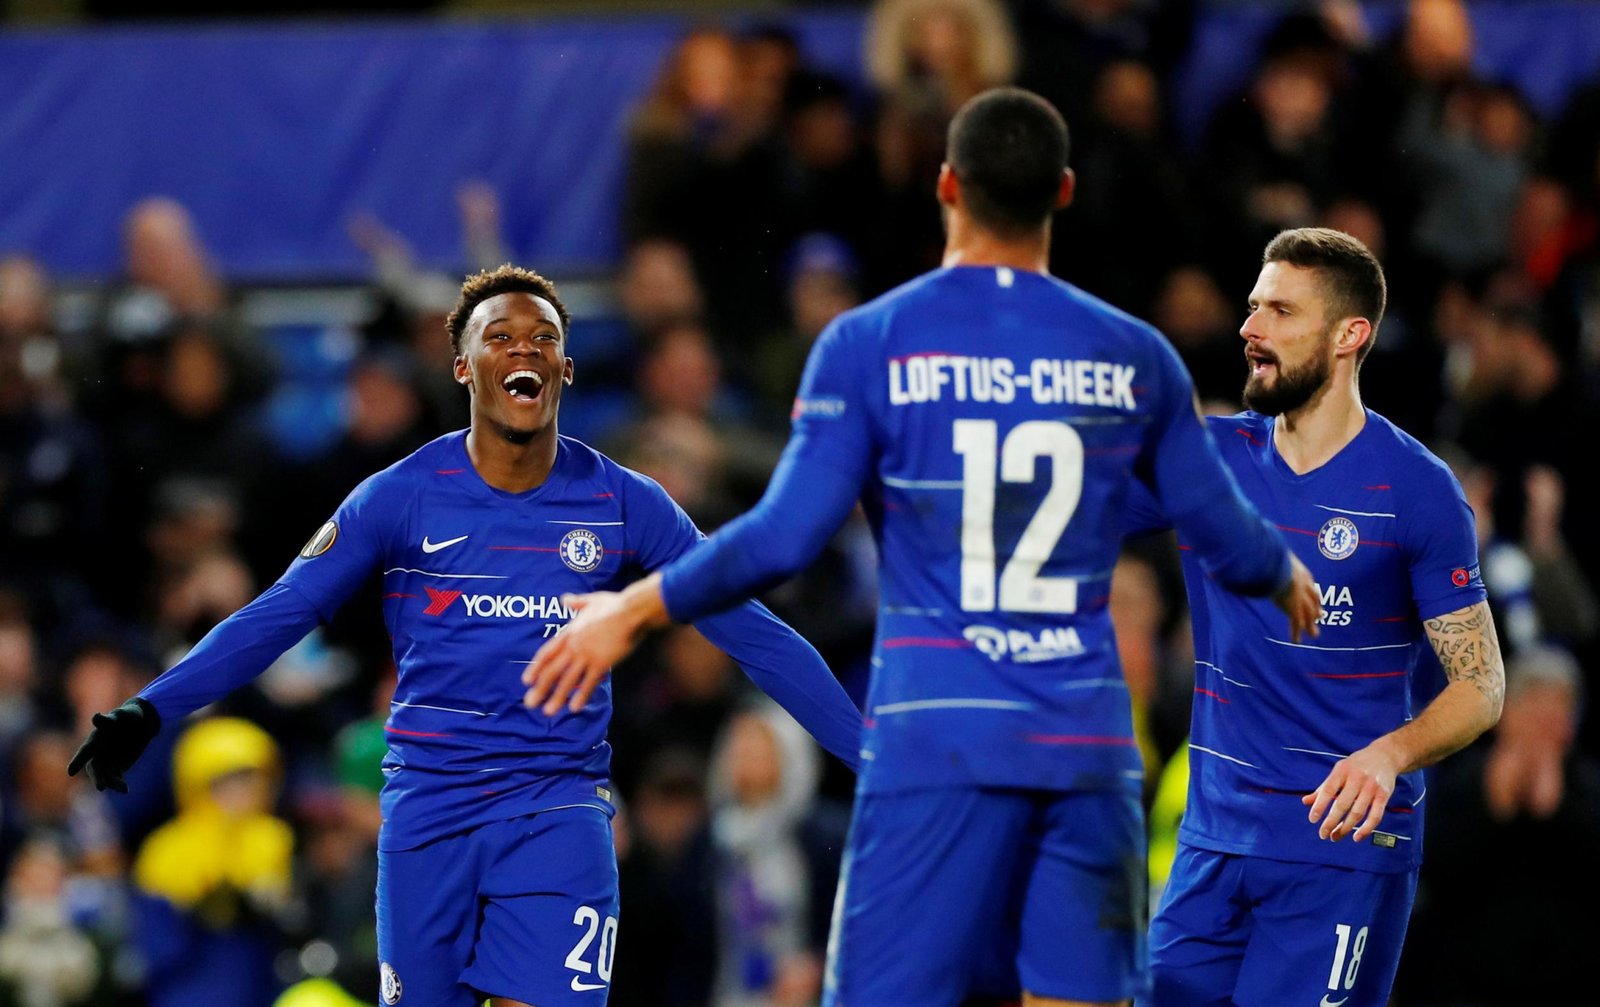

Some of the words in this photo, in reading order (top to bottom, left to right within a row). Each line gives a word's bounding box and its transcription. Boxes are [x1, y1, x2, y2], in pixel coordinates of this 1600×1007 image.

[889, 355, 1137, 410] LOFTUS-CHEEK
[952, 418, 1085, 613] 12
[1007, 626, 1081, 653] PLAN
[564, 905, 618, 982] 20
[1327, 923, 1368, 991] 18
